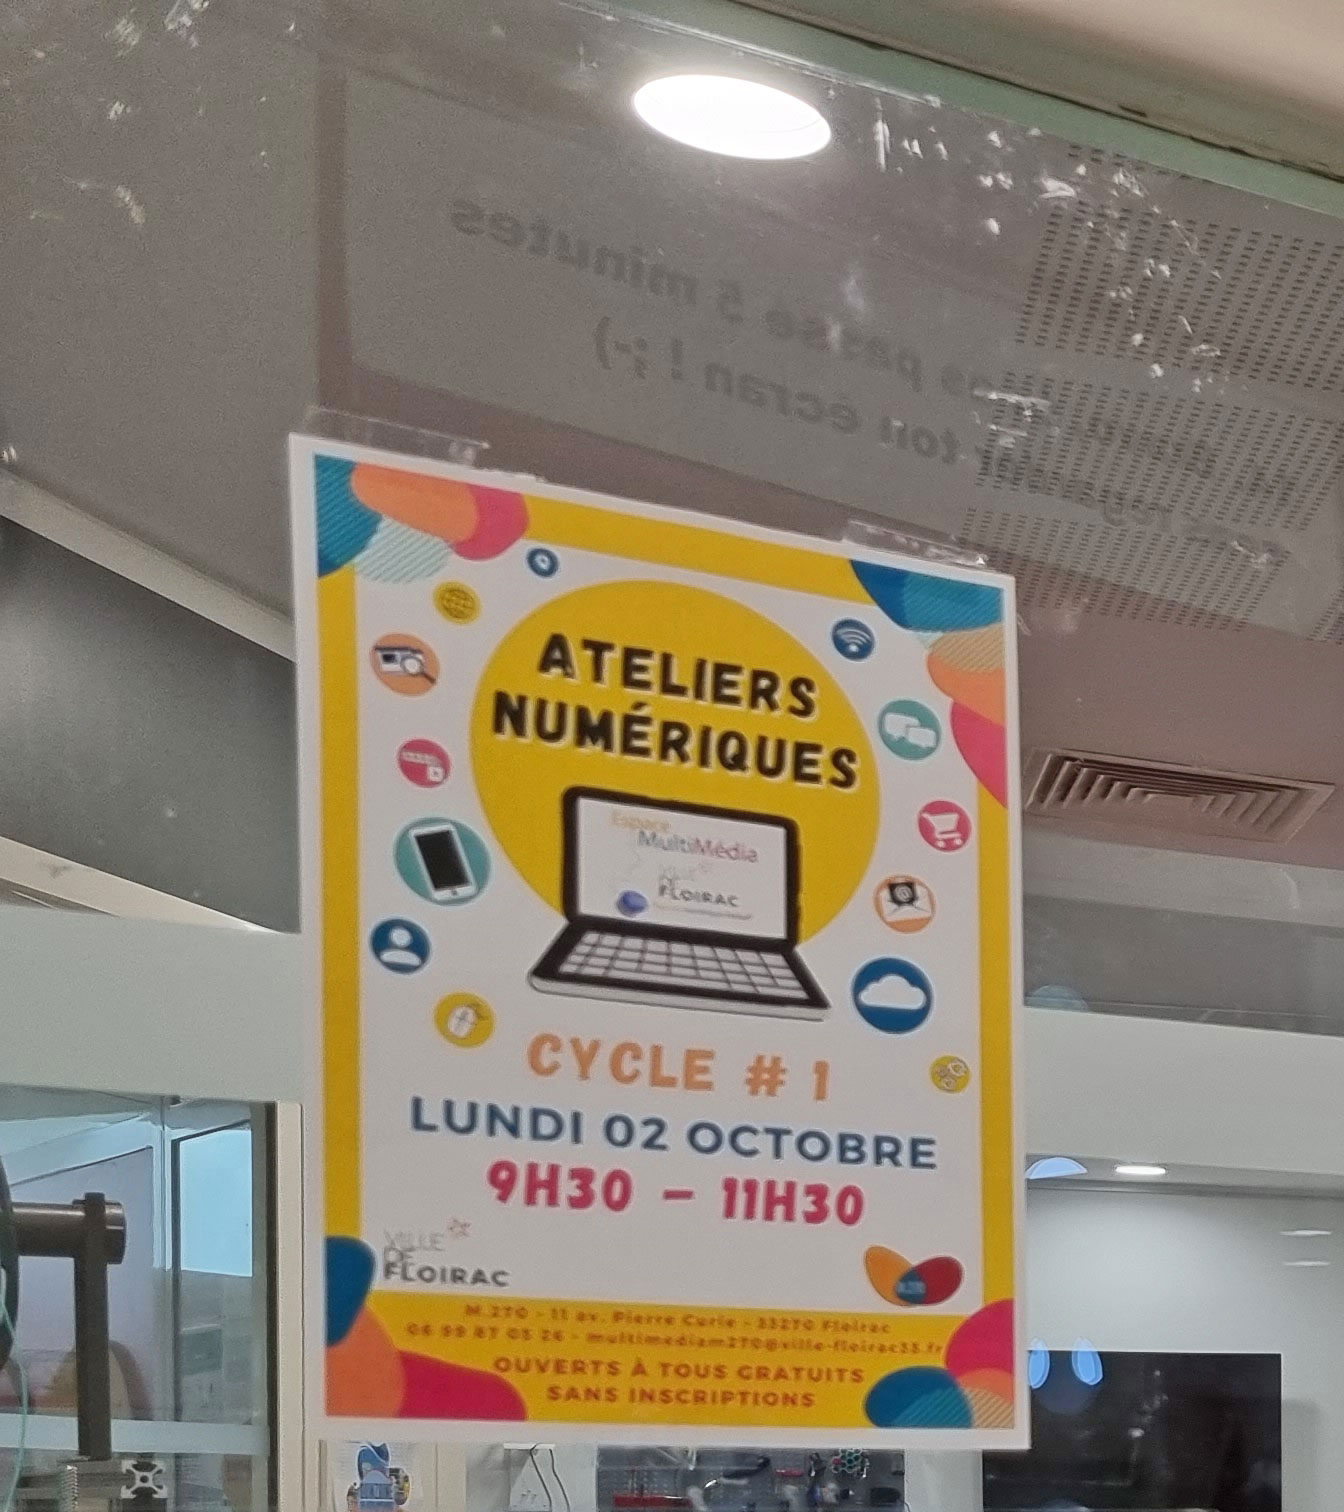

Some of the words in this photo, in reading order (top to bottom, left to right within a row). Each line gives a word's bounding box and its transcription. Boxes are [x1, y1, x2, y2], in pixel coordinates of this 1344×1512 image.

[538, 633, 817, 718] ATELIERS
[492, 690, 859, 790] NUMÉRIQUES
[528, 1032, 715, 1092] CYCLE
[745, 1054, 787, 1097] #
[811, 1060, 830, 1101] 1
[409, 1096, 584, 1145] LUNDI
[604, 1114, 669, 1152] 02
[687, 1120, 938, 1170] OCTOBRE
[485, 1160, 633, 1212] 9H30
[722, 1177, 865, 1226] 11H30
[383, 1262, 510, 1287] FLOIRAC
[493, 1357, 621, 1377] OUVERTS
[660, 1362, 727, 1381] TOUS
[737, 1364, 865, 1385] GRATUITS
[547, 1385, 618, 1404] SANS
[629, 1387, 815, 1408] INSCRIPTIONS
